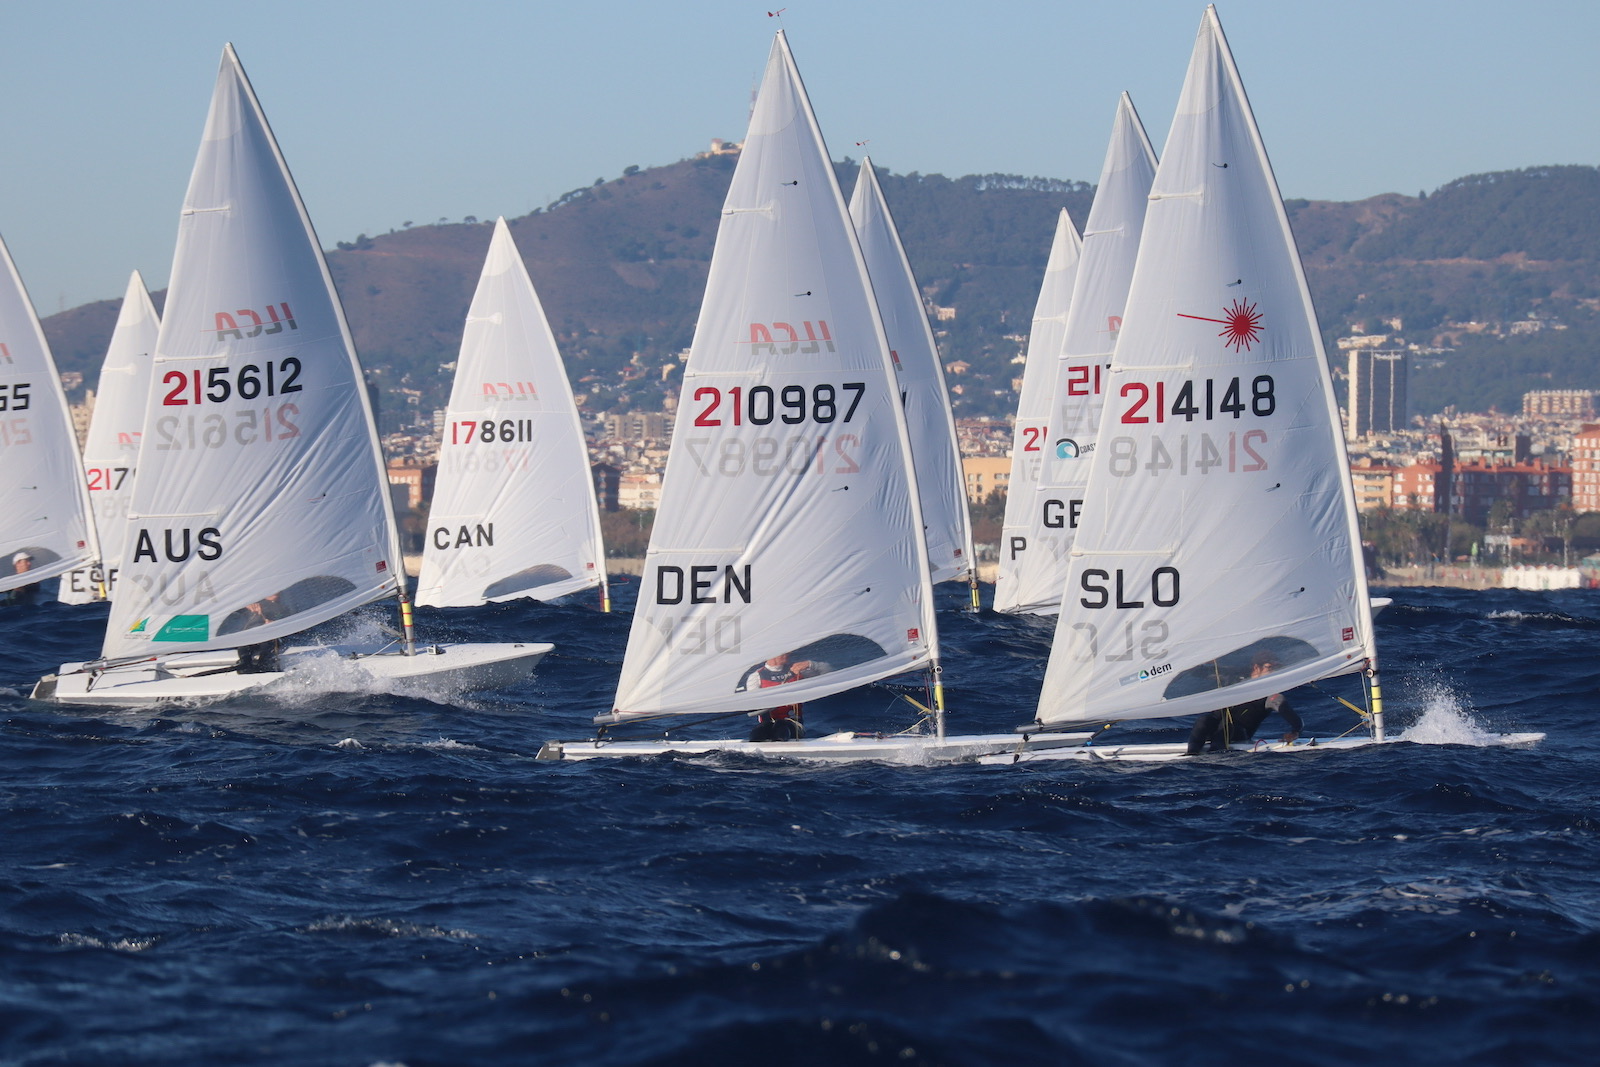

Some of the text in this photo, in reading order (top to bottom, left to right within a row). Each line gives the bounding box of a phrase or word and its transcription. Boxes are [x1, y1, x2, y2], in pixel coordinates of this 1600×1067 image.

[163, 357, 303, 406] 215612
[1068, 364, 1111, 396] 21
[693, 382, 866, 427] 210987
[1120, 375, 1276, 424] 214148
[452, 419, 532, 445] 178611
[88, 468, 137, 491] 217
[133, 528, 223, 563] AUS
[434, 523, 494, 550] CAN
[656, 565, 752, 605] DEN
[1080, 566, 1180, 609] SLO
